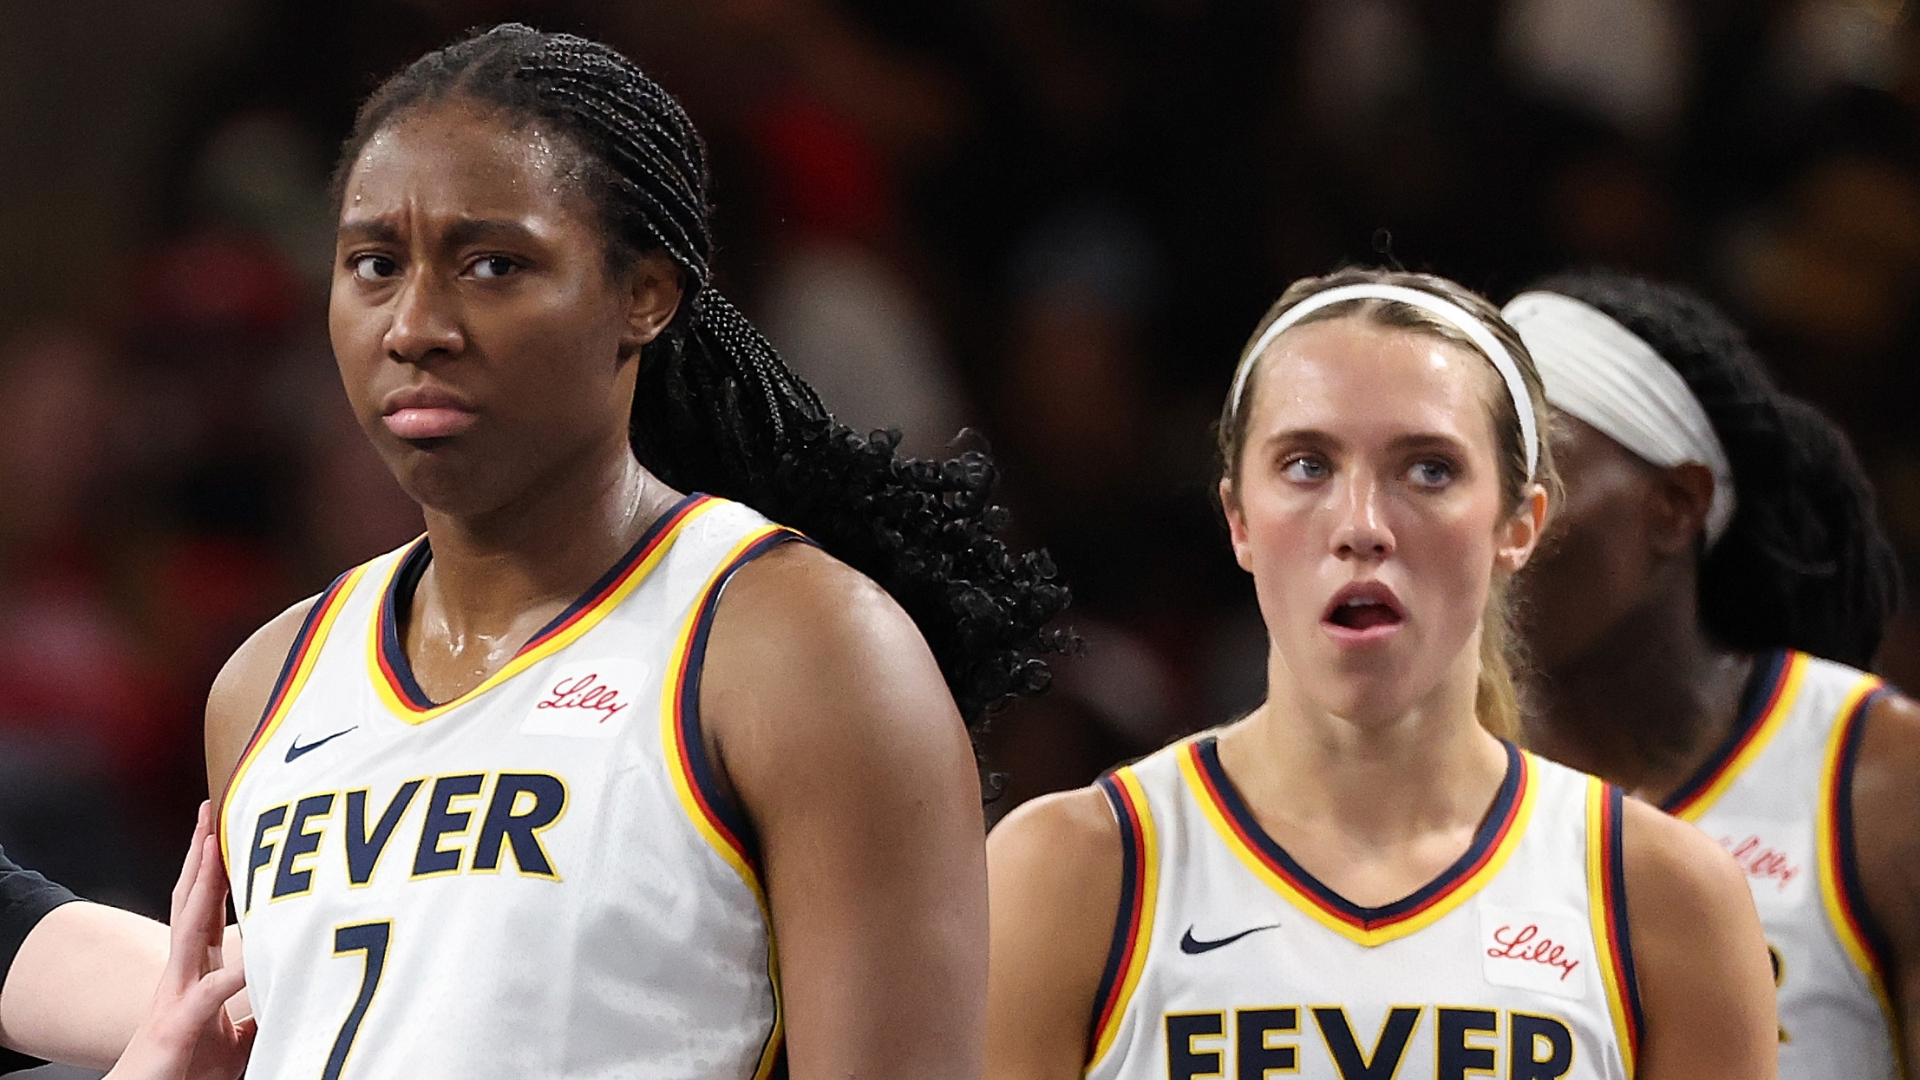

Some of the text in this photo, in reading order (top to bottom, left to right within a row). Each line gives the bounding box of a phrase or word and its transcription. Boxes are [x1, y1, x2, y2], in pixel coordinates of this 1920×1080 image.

[537, 673, 628, 724] Lilly
[244, 770, 569, 917] FEVER
[1487, 924, 1580, 981] Lilly
[320, 918, 394, 1080] 7
[1163, 1004, 1575, 1080] FEVER
